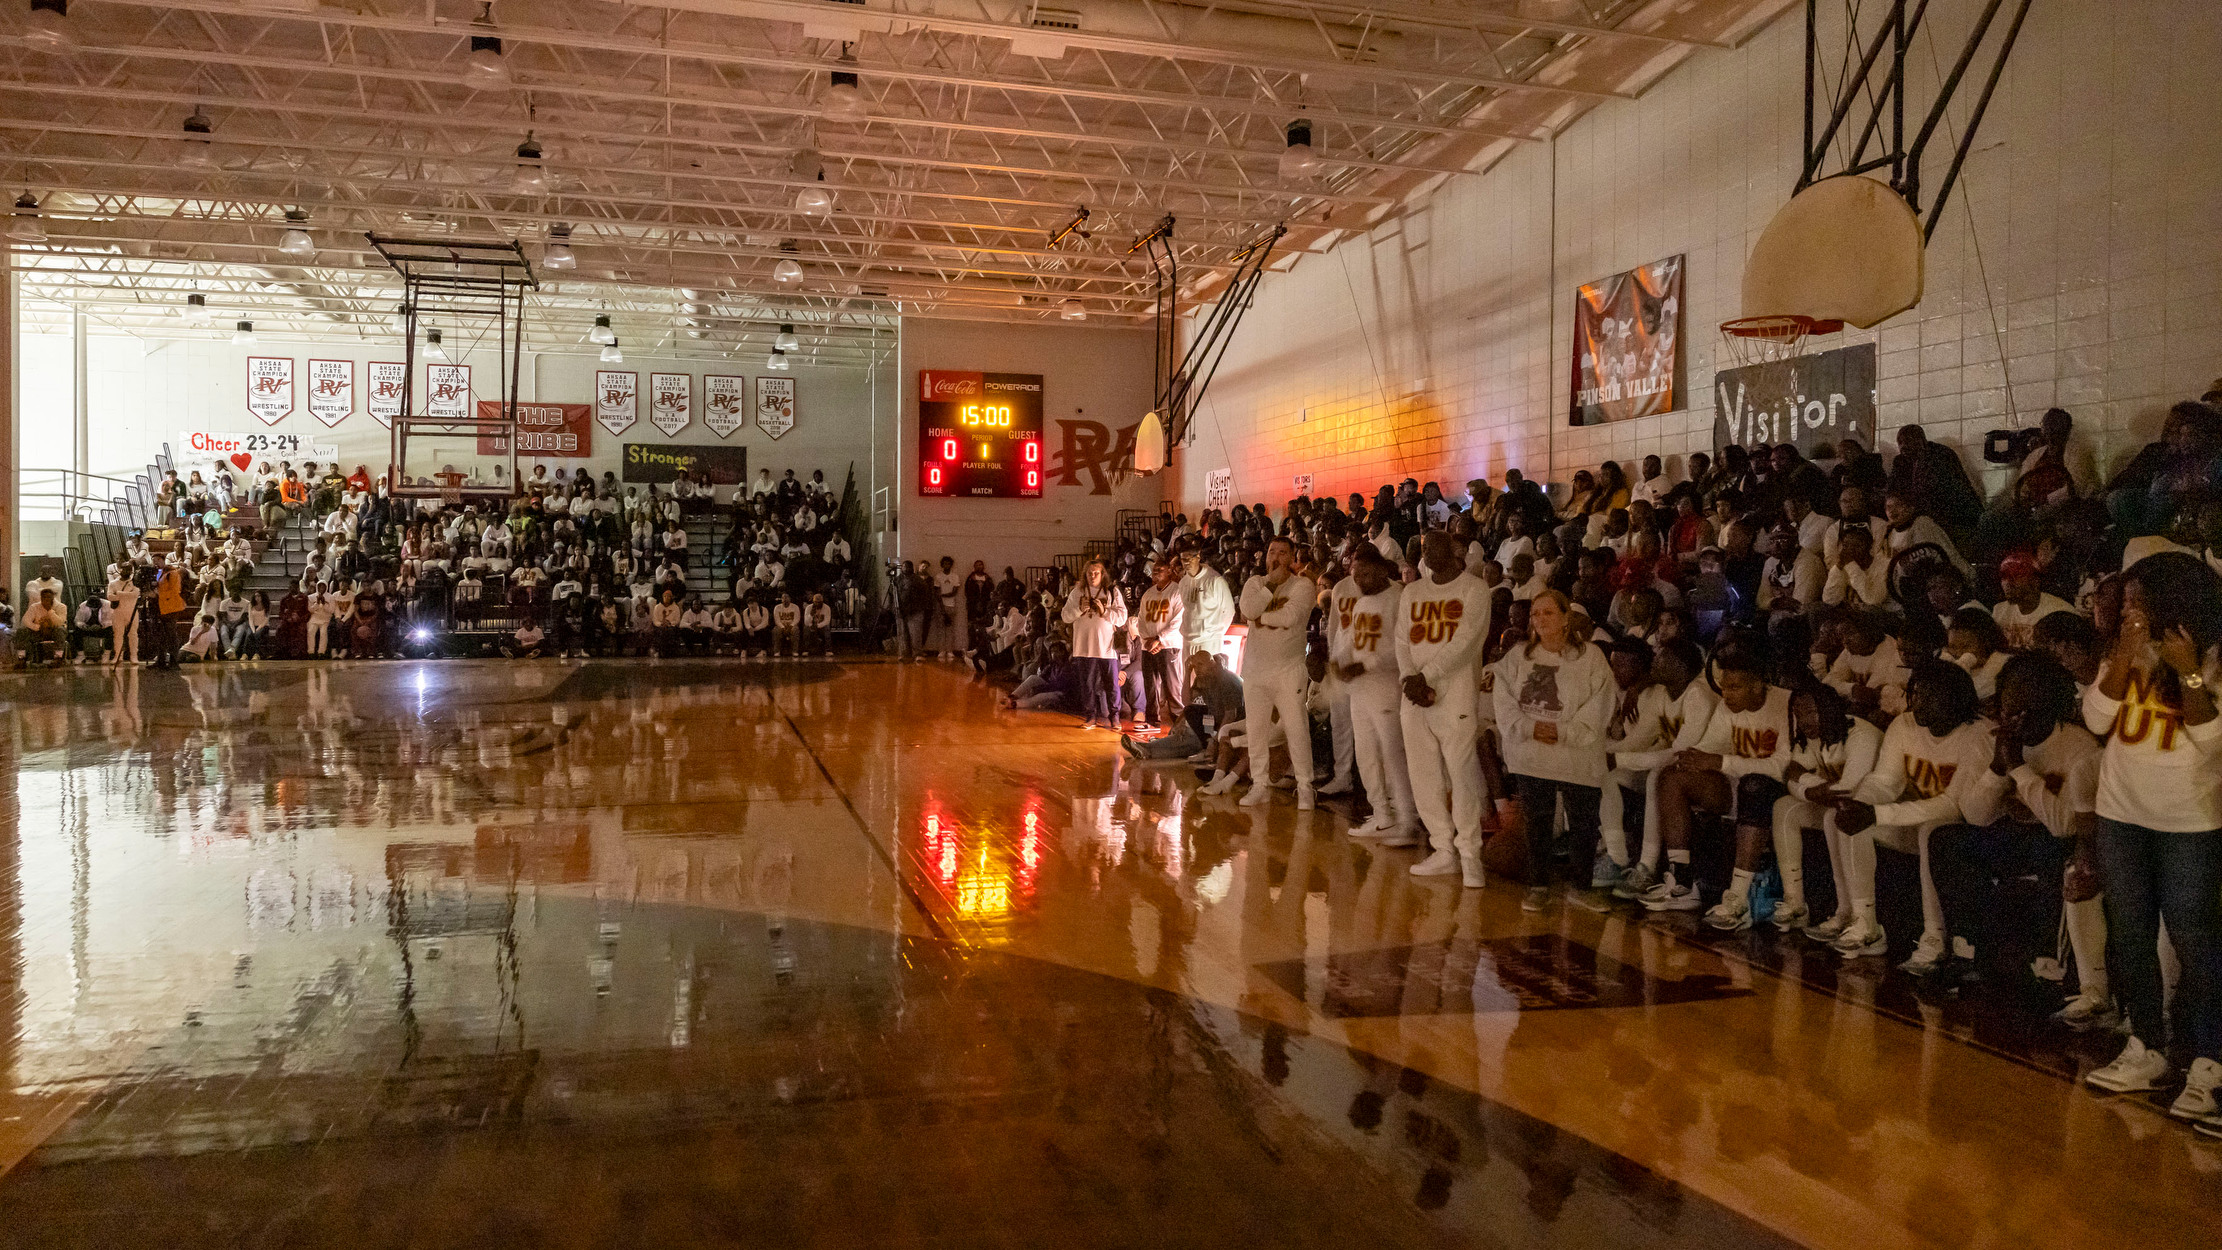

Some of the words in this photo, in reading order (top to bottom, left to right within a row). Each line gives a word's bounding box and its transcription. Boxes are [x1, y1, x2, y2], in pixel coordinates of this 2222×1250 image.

[934, 379, 977, 394] Coca-Cola
[984, 382, 1041, 391] POWERADE
[1576, 382, 1621, 407] PINSON
[504, 406, 563, 425] THE
[962, 405, 1010, 426] 15:00
[191, 432, 240, 451] Cheer
[246, 434, 299, 451] 23-24
[490, 429, 577, 451] TRIBE
[928, 428, 954, 437] HOME
[1008, 430, 1036, 440] GUEST
[628, 445, 697, 468] Stronger
[944, 440, 956, 460] 0
[1025, 442, 1037, 462] 0
[931, 468, 941, 484] 0
[1027, 470, 1037, 486] 0
[1020, 488, 1039, 496] SCORE
[1208, 488, 1228, 507] CHEER
[1145, 599, 1170, 611] UNO
[1410, 598, 1464, 622] UNO
[1145, 611, 1169, 623] OUT
[1353, 632, 1382, 651] UT
[1409, 621, 1459, 645] OUT
[2117, 702, 2180, 751] UT
